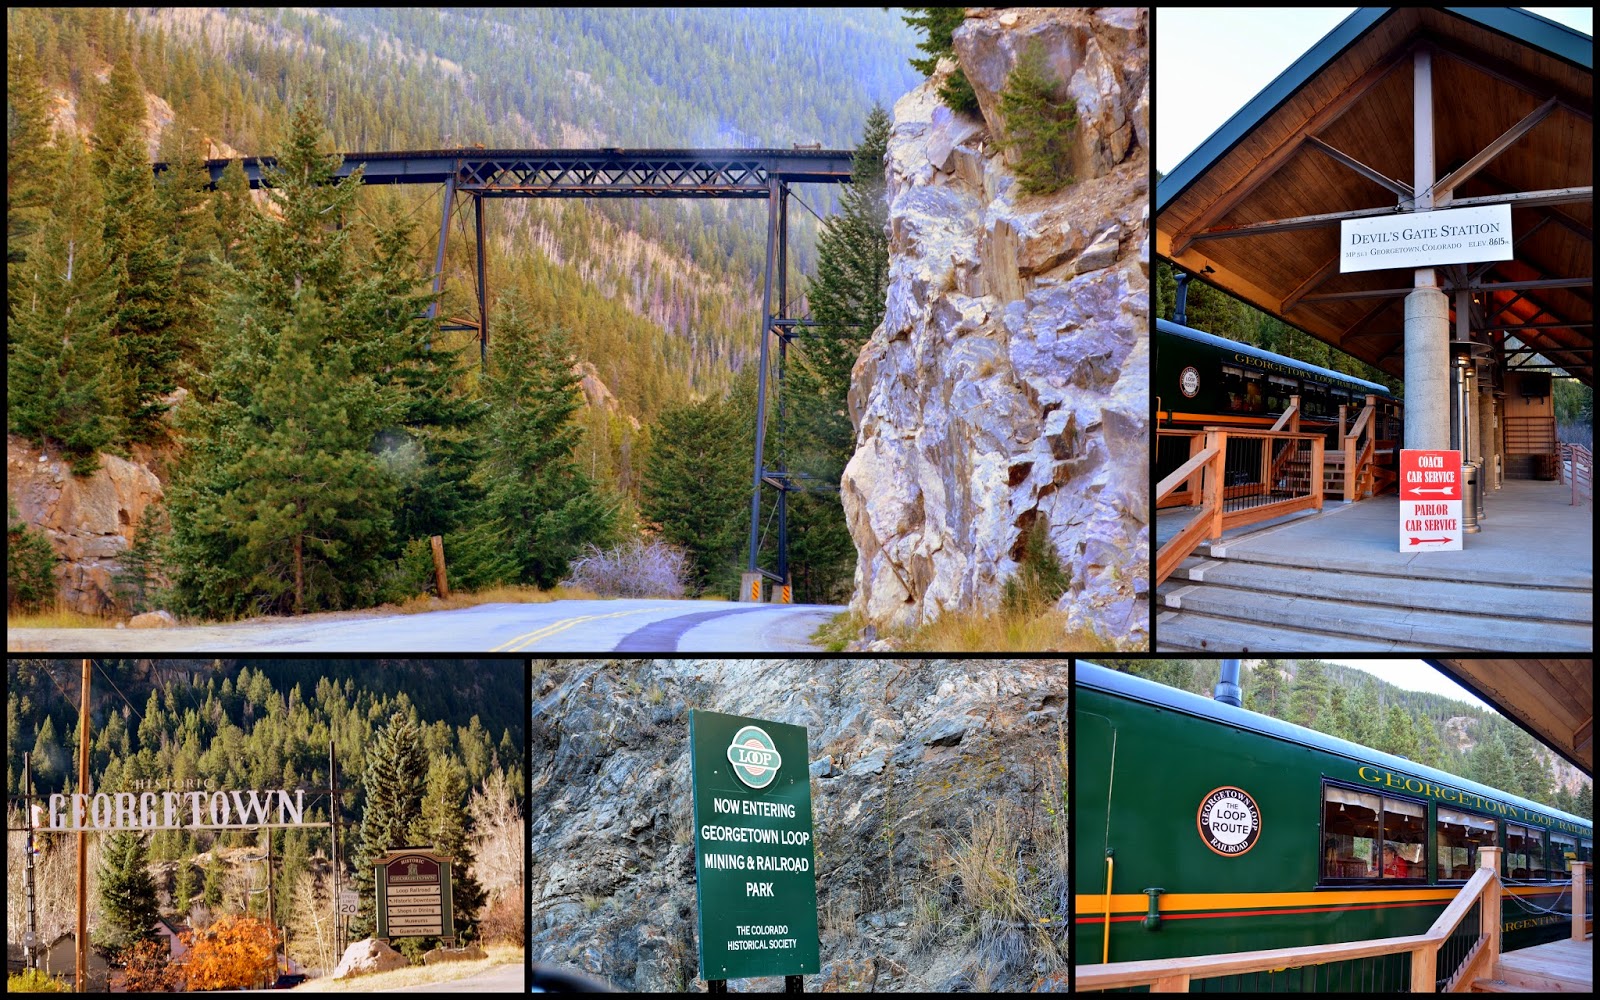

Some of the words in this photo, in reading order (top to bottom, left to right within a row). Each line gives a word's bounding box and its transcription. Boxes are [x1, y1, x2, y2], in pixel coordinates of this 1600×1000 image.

[1352, 231, 1399, 245] DEVIL'S
[1402, 228, 1438, 241] GATE
[1440, 222, 1500, 238] STATION
[1421, 242, 1462, 252] COLORADO
[1234, 353, 1312, 379] GEORGETOWN
[1314, 374, 1335, 385] LOOP
[1418, 456, 1443, 468] COACH
[1407, 471, 1422, 482] CAR
[1424, 471, 1455, 482] SERVICE
[1414, 504, 1448, 516] PARLOR
[1405, 520, 1422, 531] CAR
[1424, 519, 1457, 531] SERVICE
[738, 749, 772, 766] LOOP
[135, 778, 215, 790] HISTORIC
[1358, 766, 1518, 818] GEORGETOWN
[1524, 811, 1555, 827] LOOP
[49, 788, 306, 829] GEORGETOWN
[714, 797, 740, 815] NOW
[742, 800, 796, 818] ENTERING
[1201, 790, 1251, 826] GEORGETOWN
[1216, 809, 1247, 821] LOOP
[1212, 821, 1249, 834] ROUTE
[701, 825, 779, 845] GEORGETOWN
[780, 830, 810, 846] LOOP
[1210, 837, 1249, 853] RAILROAD
[704, 853, 745, 871] MINING
[746, 856, 755, 871] &
[756, 856, 809, 872] RAILROAD
[746, 882, 774, 897] PARK
[341, 903, 356, 913] 20
[736, 926, 750, 936] THE
[750, 925, 789, 936] COLORADO
[727, 940, 769, 951] HISTORICAL
[769, 939, 797, 950] SOCIETY
